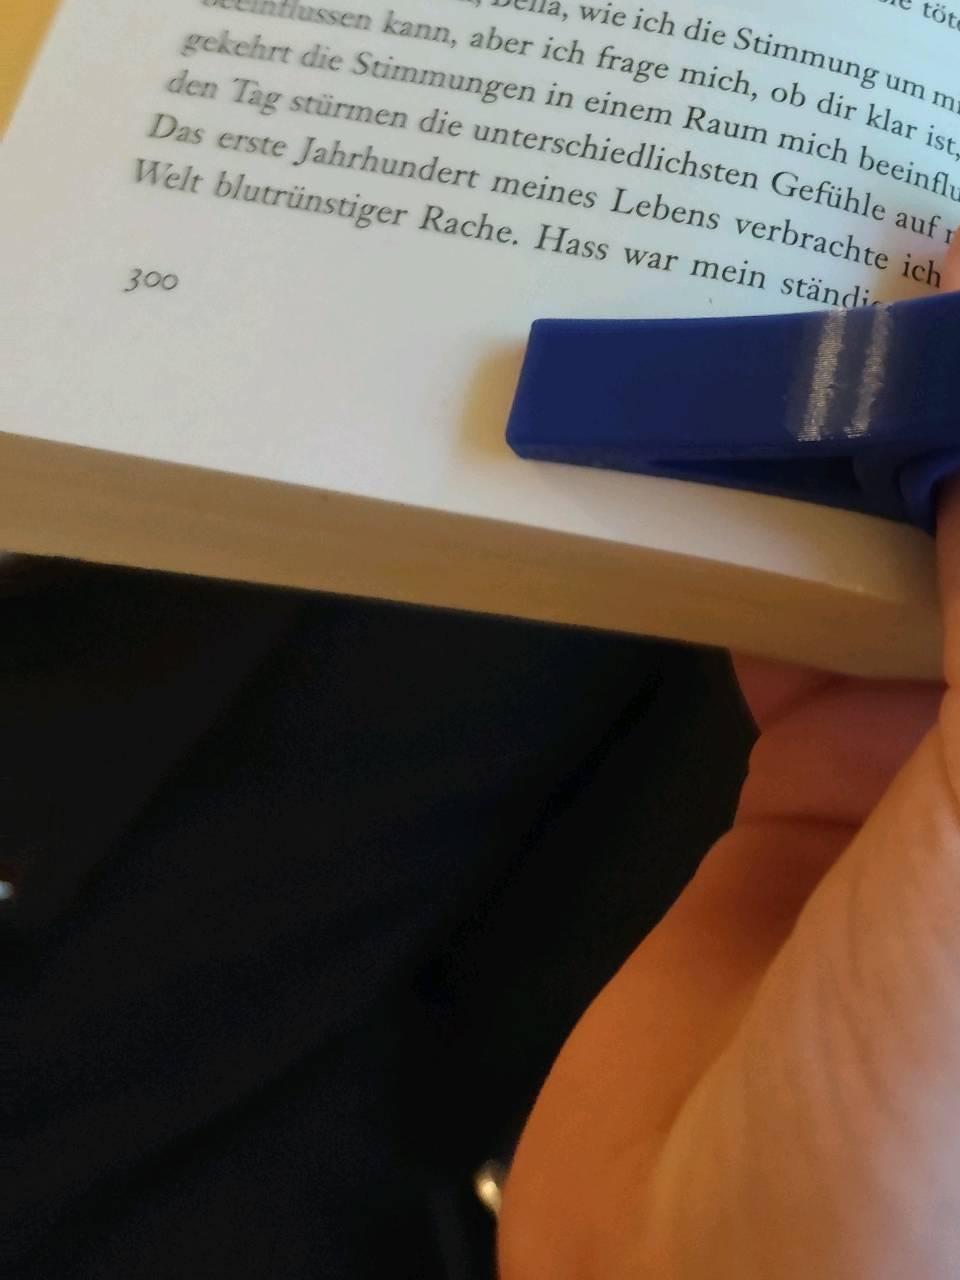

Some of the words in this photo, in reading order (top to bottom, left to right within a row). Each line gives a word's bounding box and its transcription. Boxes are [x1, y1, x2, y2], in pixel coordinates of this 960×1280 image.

[178, 29, 293, 64] gekehrt
[296, 43, 344, 72] die
[350, 51, 536, 104] Stimmungen
[543, 82, 574, 109] in
[583, 91, 672, 126] einem
[682, 105, 768, 145] Raum
[776, 132, 848, 165] mich
[379, 9, 458, 48] kann,
[468, 25, 535, 56] aber
[540, 36, 585, 66] ich
[595, 45, 670, 84] frage
[678, 66, 758, 102] mich,
[769, 82, 807, 108] ob
[815, 91, 858, 121] dir
[864, 103, 918, 140] klar
[924, 124, 960, 162] ist,
[578, 2, 627, 27] wie
[631, 7, 676, 37] ich
[682, 17, 727, 46] die
[732, 27, 880, 90] Stimmung
[885, 73, 925, 101] um
[145, 112, 205, 145] Das
[214, 132, 288, 158] erste
[294, 136, 479, 189] Jahrhundert
[490, 175, 598, 209] meines
[610, 187, 720, 230] Lebens
[735, 218, 888, 270] verbrachte
[900, 253, 941, 288] ich
[162, 68, 219, 100] den
[231, 77, 284, 117] Tag
[287, 94, 408, 129] stürmen
[416, 108, 464, 138] die
[472, 125, 758, 189] unterschiedlichsten
[770, 171, 886, 221] Gefühle
[894, 212, 938, 239] auf
[122, 267, 179, 292] 300
[132, 158, 203, 194] Welt
[212, 171, 408, 229] blutrünstiger
[417, 204, 518, 246] Rache.
[533, 223, 609, 261] Hass
[623, 247, 679, 272] war
[689, 259, 766, 289] mein
[782, 277, 884, 310] ständi
